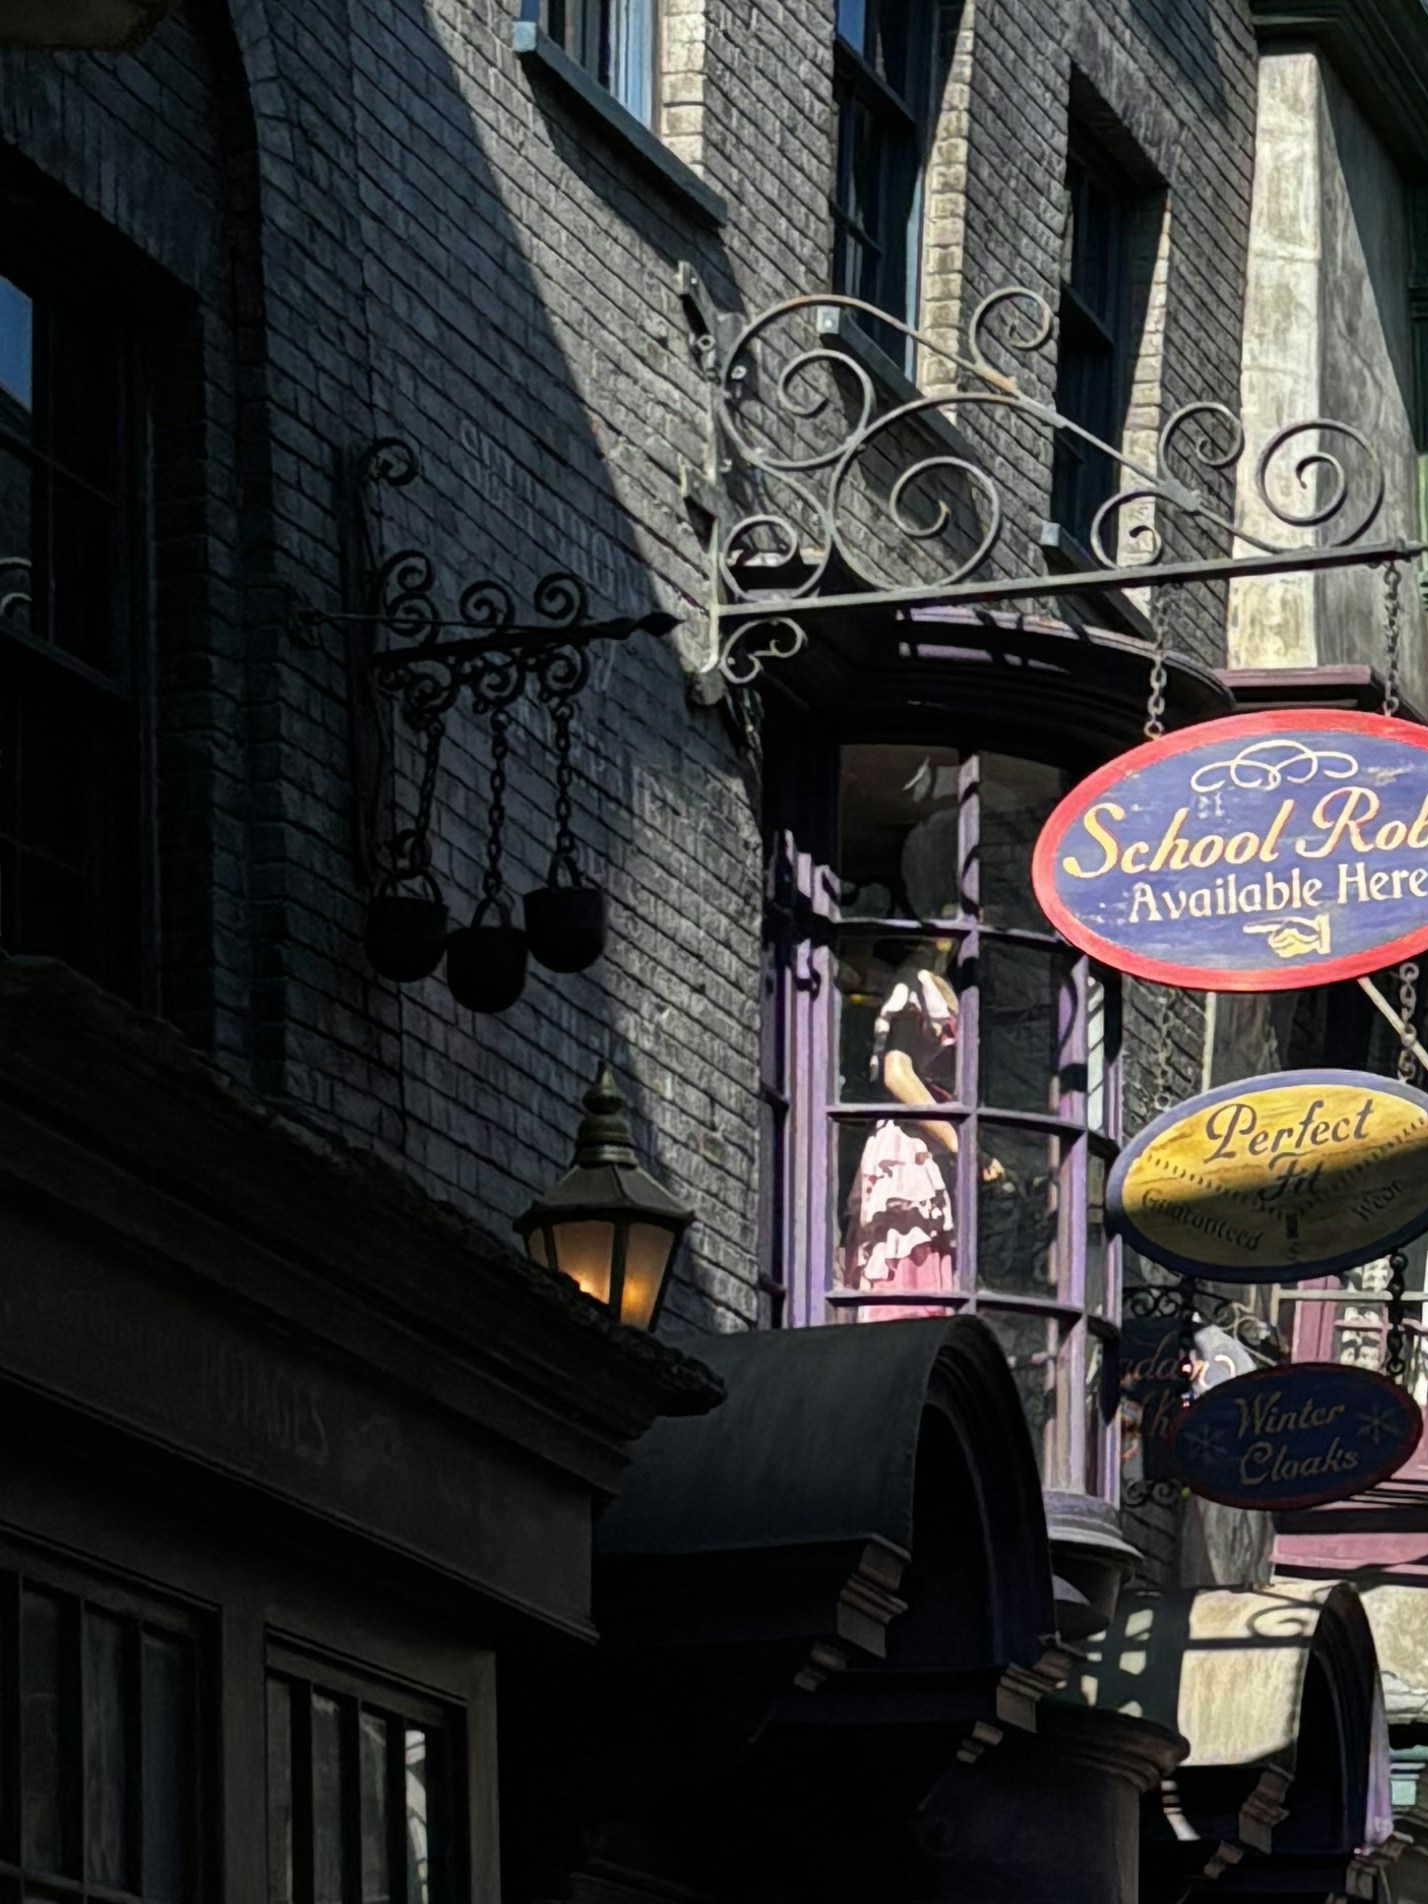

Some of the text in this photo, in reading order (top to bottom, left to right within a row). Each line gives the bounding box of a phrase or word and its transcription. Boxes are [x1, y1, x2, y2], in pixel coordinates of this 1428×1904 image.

[1063, 799, 1294, 879] School
[1128, 868, 1323, 923] Available
[1203, 1099, 1374, 1163] Perfect
[1258, 1149, 1325, 1201] Fit
[1141, 1188, 1265, 1252] Guaranteed
[1234, 1391, 1346, 1440] Winter
